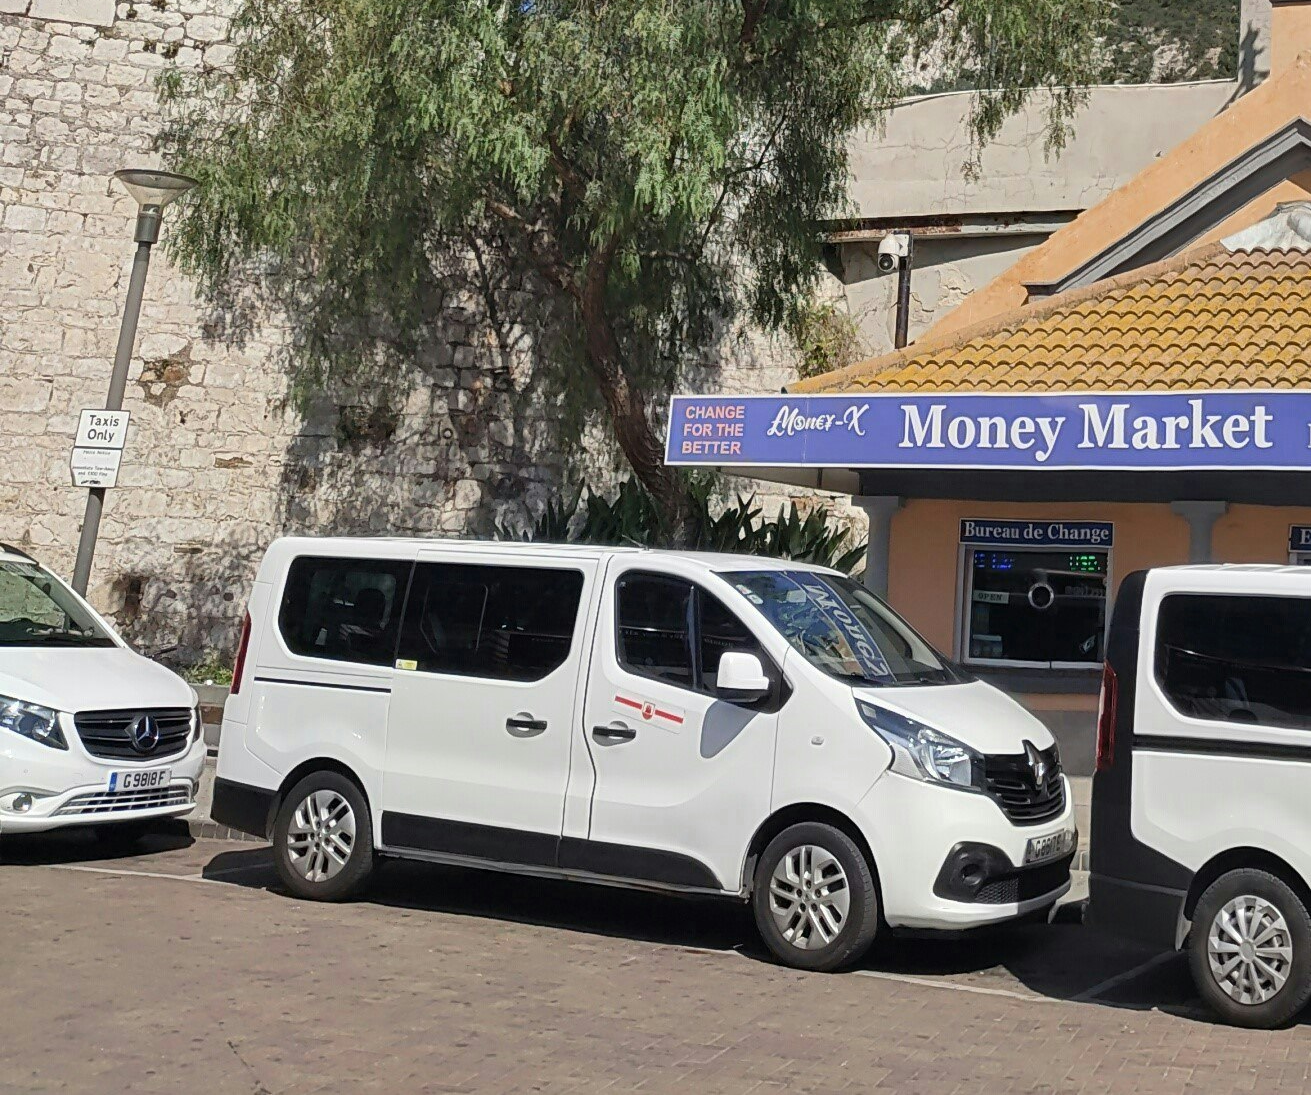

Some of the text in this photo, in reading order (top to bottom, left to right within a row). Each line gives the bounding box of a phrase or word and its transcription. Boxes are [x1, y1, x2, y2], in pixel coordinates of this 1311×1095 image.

[685, 405, 745, 419] CHANGE
[89, 414, 120, 427] Taxis
[87, 428, 115, 443] Only
[683, 423, 744, 437] FOR THE
[898, 398, 1274, 463] Money Market
[681, 441, 742, 455] BETTER
[964, 521, 1110, 543] Bureau de Change
